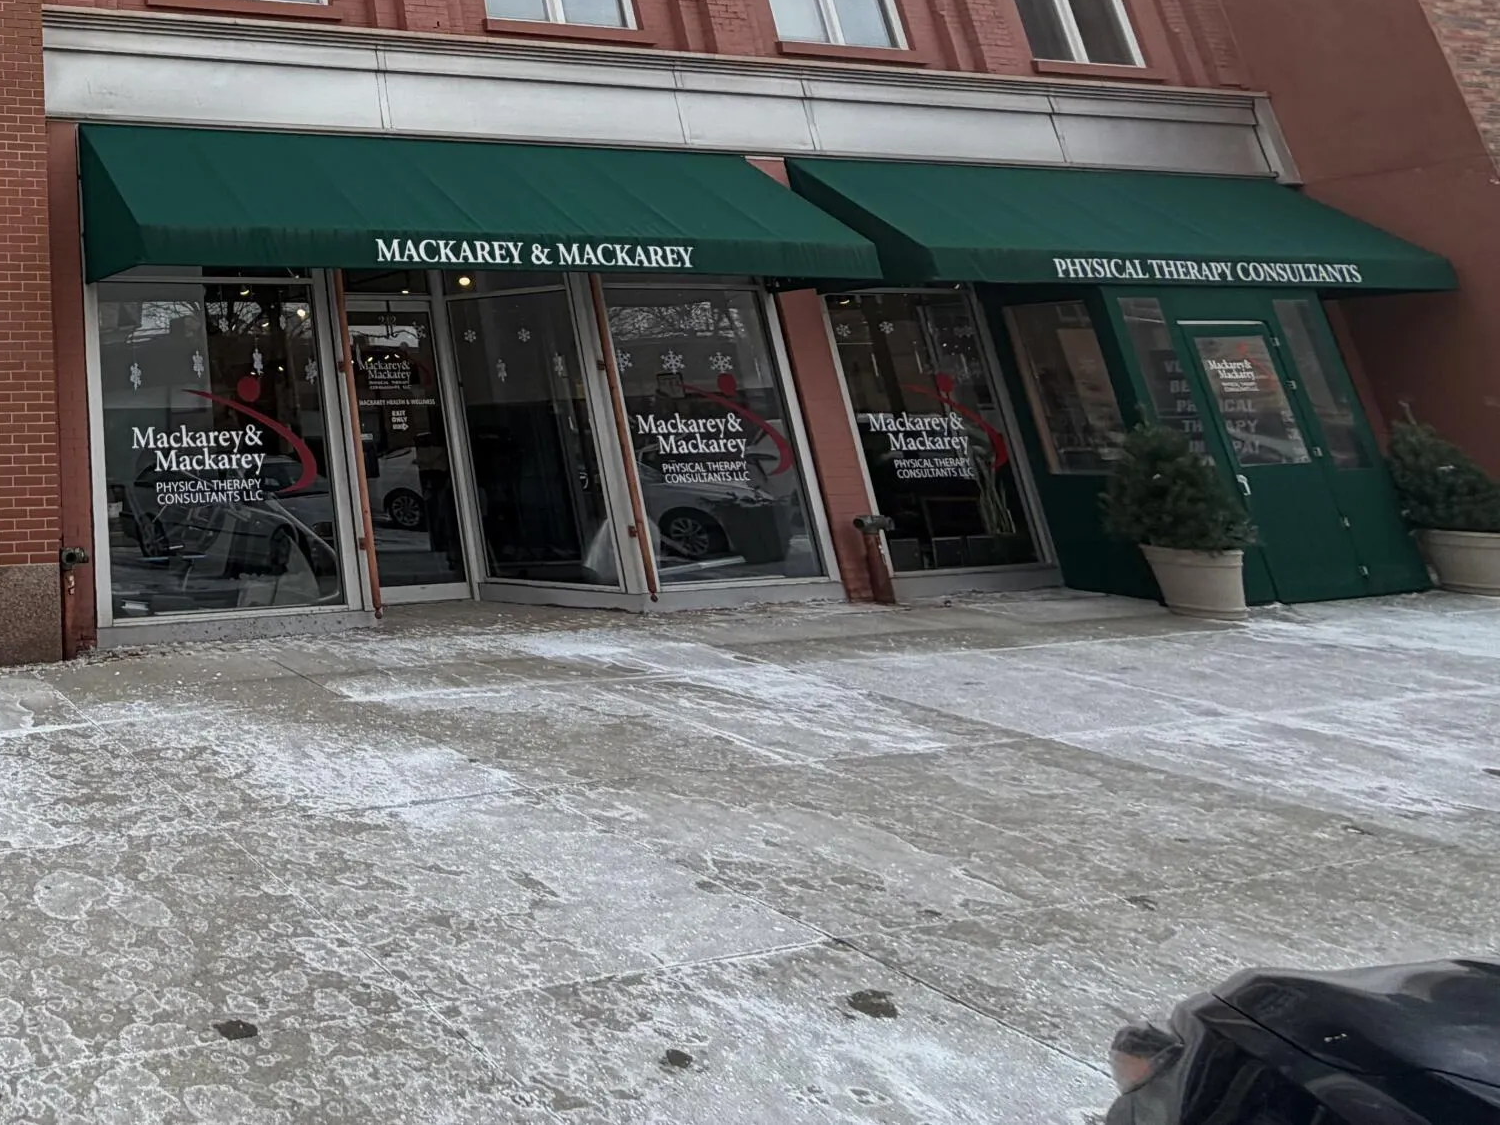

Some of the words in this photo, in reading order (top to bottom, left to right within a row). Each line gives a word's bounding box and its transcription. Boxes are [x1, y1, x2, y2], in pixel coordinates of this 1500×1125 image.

[376, 238, 523, 263] MACKAREY
[531, 243, 552, 264] &
[556, 243, 694, 268] MACKAREY
[1054, 258, 1148, 279] PHYSICAL
[1148, 259, 1235, 281] THERAPY
[1236, 262, 1362, 283] CONSULTANTS
[657, 433, 747, 458] Mackarey
[887, 431, 969, 455] Mackarey
[154, 447, 266, 476] Mackarey
[662, 462, 705, 473] PHYSICAL
[706, 460, 747, 471] THERAPY
[894, 458, 934, 469] PHYSICAL
[934, 457, 971, 467] THERAPY
[665, 472, 731, 484] CONSULTANTS
[733, 471, 750, 481] LLC
[896, 468, 957, 479] CONSULTANTS
[156, 481, 211, 493] PHYSICAL
[212, 479, 261, 490] THERAPY
[157, 491, 240, 505] CONSULTANTS
[243, 490, 263, 501] LLC
